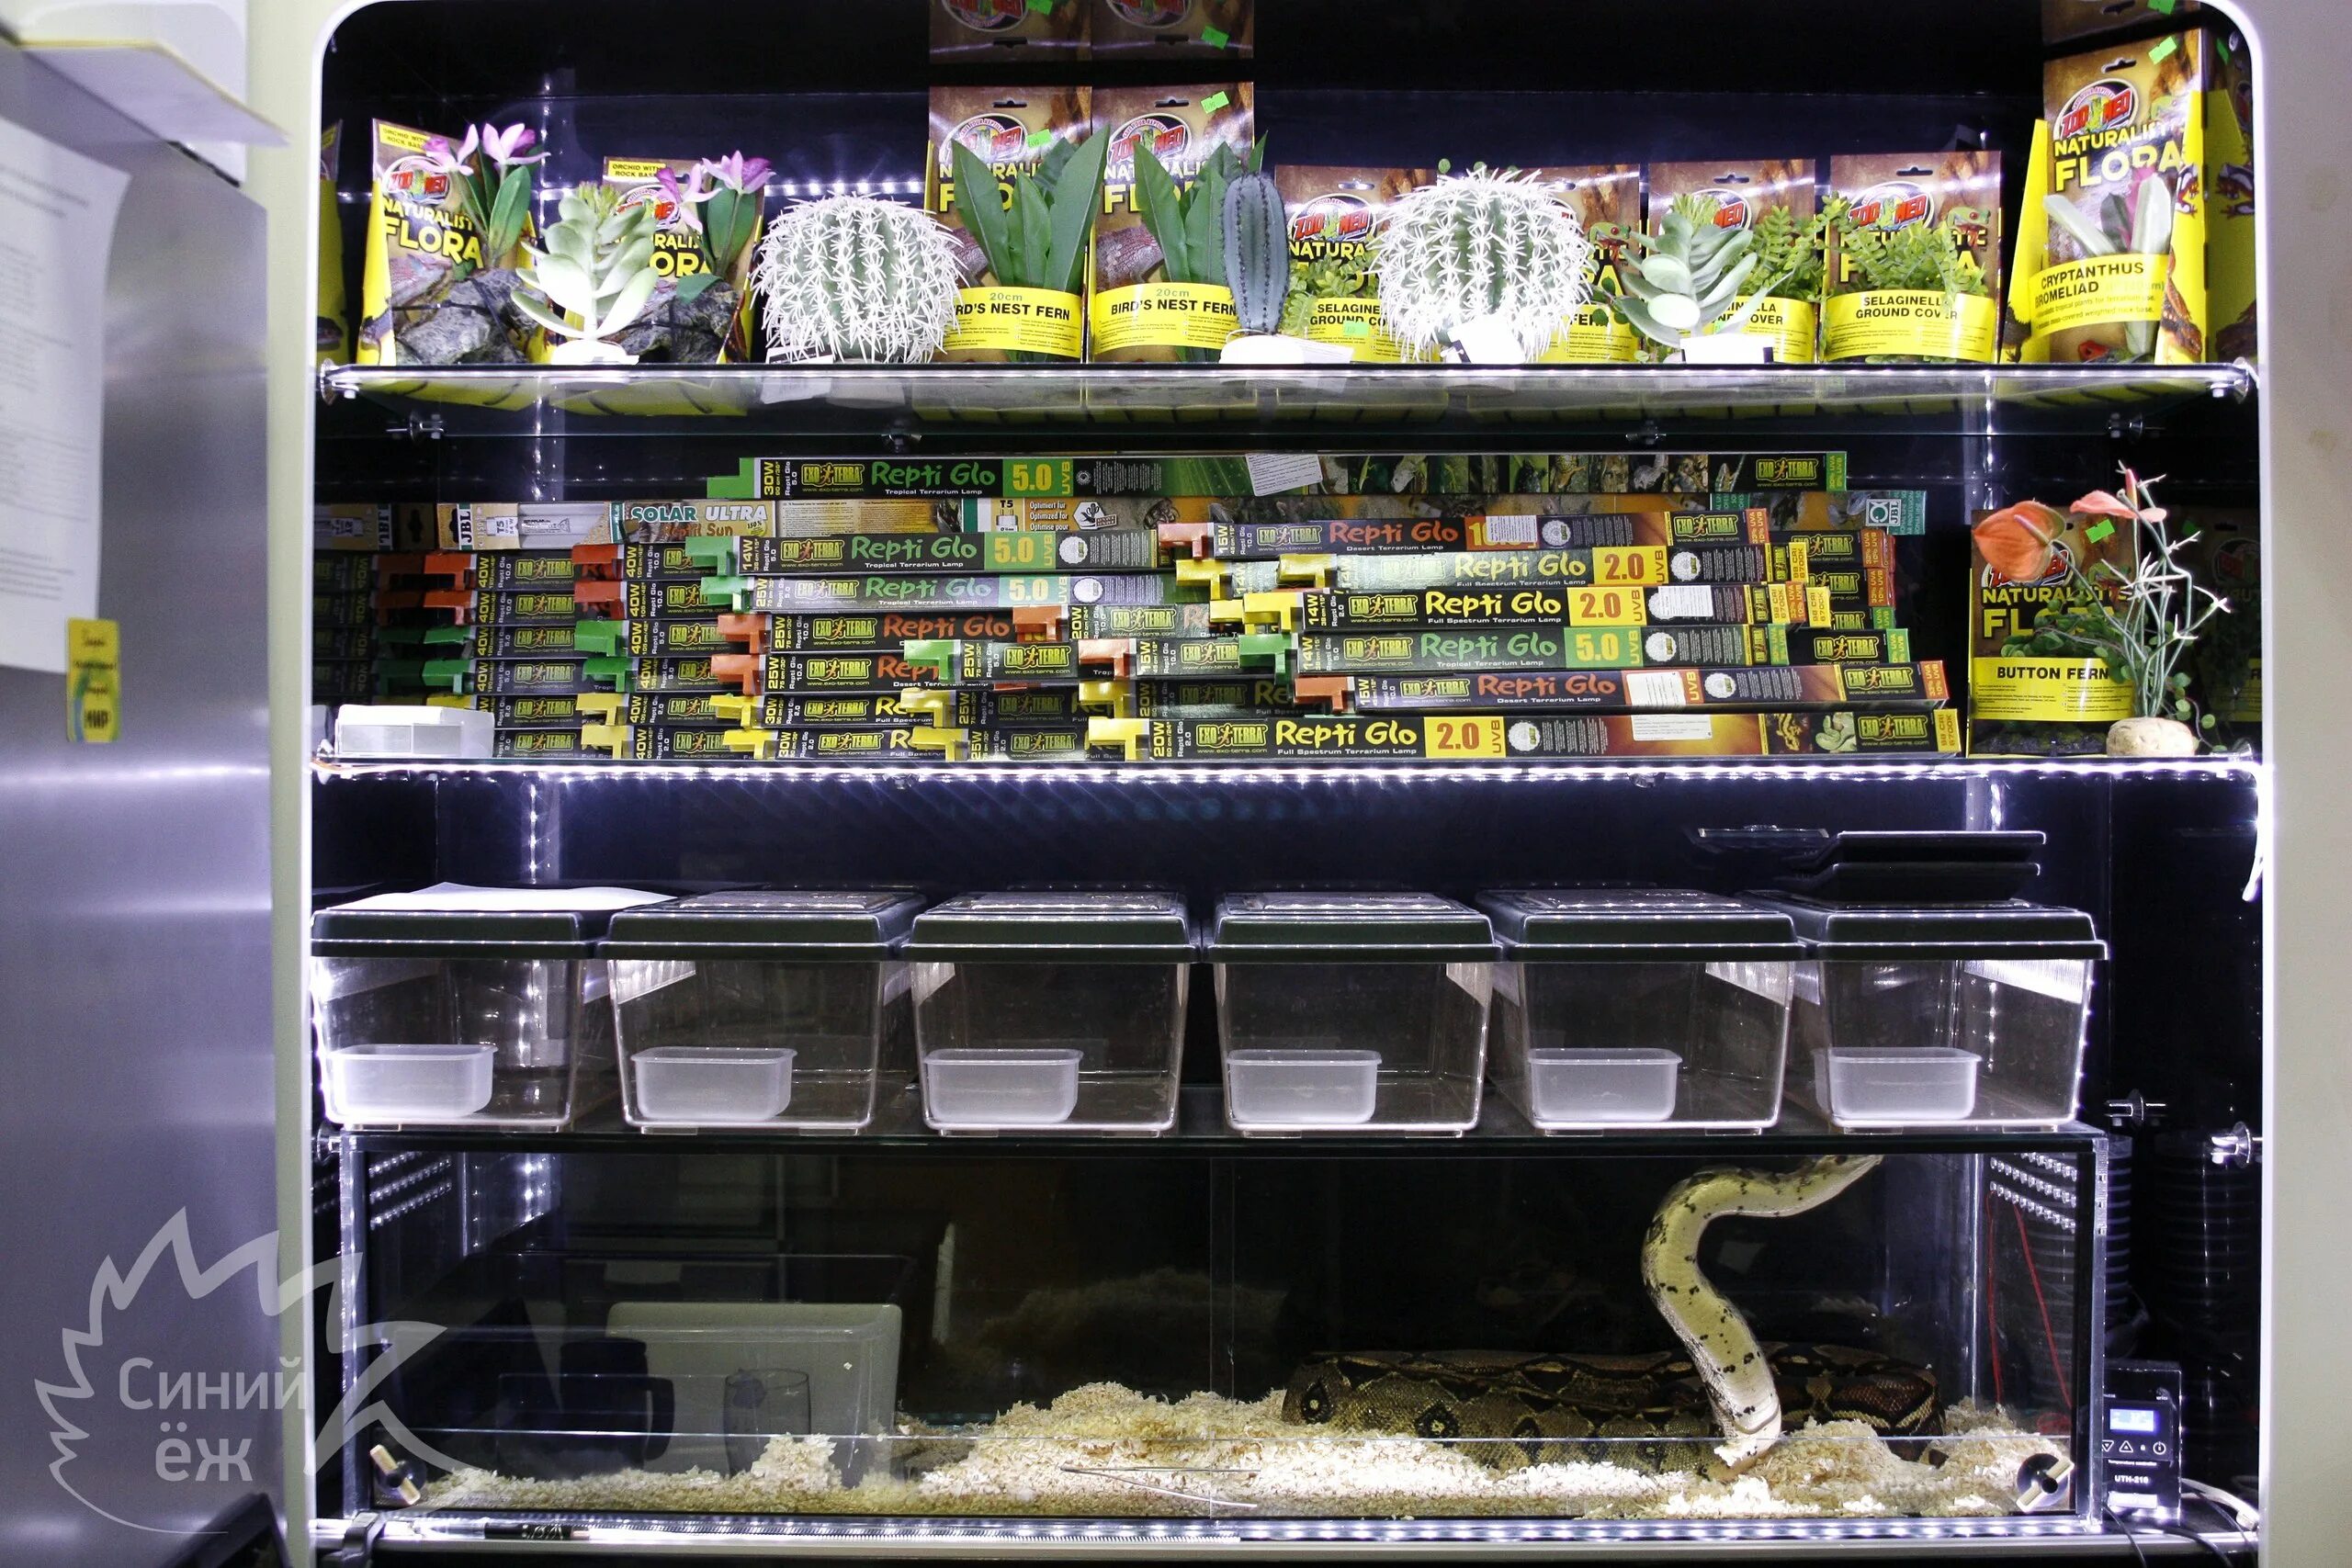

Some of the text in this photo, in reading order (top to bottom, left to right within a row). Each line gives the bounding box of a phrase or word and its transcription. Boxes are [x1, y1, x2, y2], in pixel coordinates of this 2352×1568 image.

[2055, 141, 2181, 191] FLORA
[1295, 214, 1325, 240] ZOO
[384, 216, 484, 268] FLORA
[2041, 263, 2143, 289] CRYPTANTHUS
[989, 292, 1023, 301] 20cm
[1156, 288, 1189, 297] 20cm
[1863, 296, 1940, 306] SELAGINELL
[2035, 281, 2098, 309] BROMELIAD
[952, 302, 1070, 321] RD'S NEST FERN
[1111, 299, 1237, 316] BIRD'S NEST FERN
[1317, 304, 1381, 314] SELAGINE
[1750, 314, 1783, 324] OVER
[1856, 307, 1957, 320] GROUND COVR
[763, 461, 775, 495] 30W
[872, 462, 942, 488] Repti
[950, 462, 995, 486] Glo
[1012, 464, 1052, 491] 5.0
[1061, 461, 1070, 495] UVB
[631, 506, 697, 522] SOLAR
[706, 505, 767, 521] ULTRA
[1000, 500, 1013, 508] T5
[1058, 512, 1068, 520] for
[1890, 502, 1898, 524] JBL
[461, 511, 472, 543] JBL
[707, 523, 733, 536] Sun
[1217, 525, 1228, 551] 15W
[1329, 521, 1459, 545] Repti Glo
[1676, 516, 1736, 535] EXO TERRA
[627, 546, 637, 578] 40W
[742, 538, 754, 570] 14W
[783, 541, 842, 559] EXO TERRA
[852, 534, 1053, 566] Repti Glo 5.0 UVB
[478, 558, 490, 588] 40W
[1454, 549, 1666, 583] Repti Glo 2.0 UVB
[629, 584, 639, 617] 40W
[756, 578, 766, 607] 25W
[865, 576, 1068, 604] Repti Glo 5.0 UVB
[479, 593, 490, 624] 40W
[1426, 591, 1502, 617] Repti
[1510, 591, 1562, 614] Glo
[1579, 592, 1622, 618] 2.0
[1634, 589, 1643, 622] UVB
[630, 622, 642, 654] 40W
[775, 616, 786, 649] 25W
[815, 620, 874, 637] EXO TERRA
[883, 613, 1010, 640] Repti Glo
[965, 643, 974, 678] 25W
[1006, 648, 1068, 666] EXO TERRA
[1140, 641, 1151, 672] 15W
[1303, 637, 1313, 671] 14W
[1420, 630, 1640, 665] Repti Glo 5.0 UVB
[477, 661, 488, 692] 40W
[640, 659, 651, 689] 40W
[768, 657, 778, 689] 25W
[808, 660, 868, 678] EXO TERRA
[1997, 667, 2109, 679] BUTTON FERN
[1477, 674, 1556, 697] Repti
[1565, 673, 1616, 694] Glo
[1688, 671, 1700, 701] UVB
[630, 695, 641, 724] 40W
[637, 728, 647, 760] 40W
[1153, 721, 1165, 757] 20W
[1198, 726, 1265, 745] EXO TERRA
[1276, 719, 1501, 753] Repti Glo 2.0 UVB
